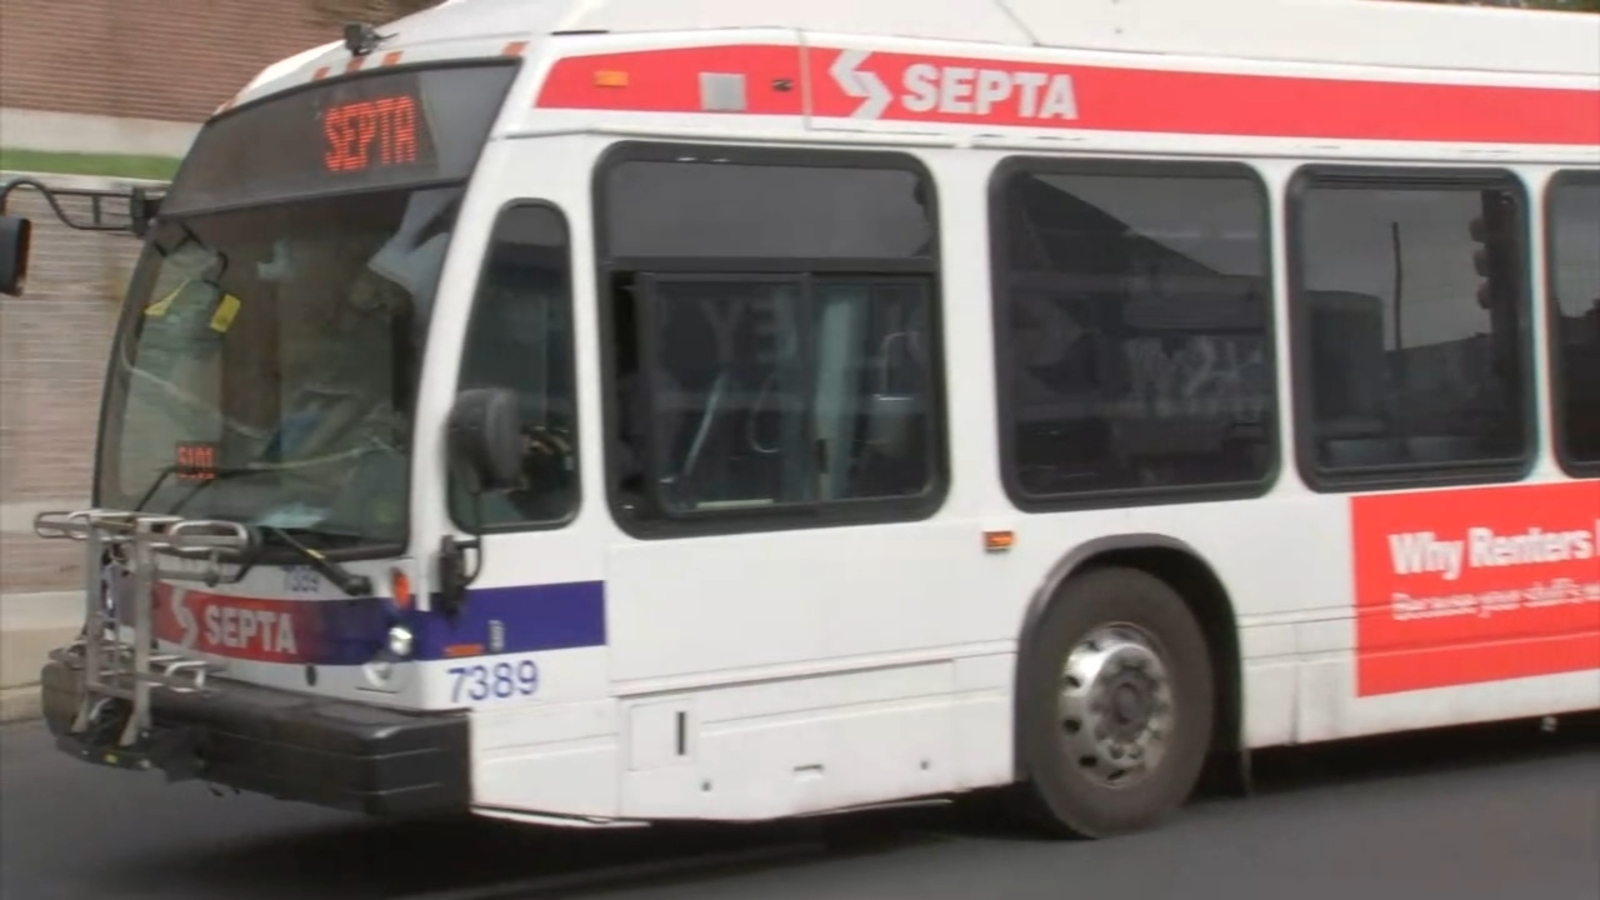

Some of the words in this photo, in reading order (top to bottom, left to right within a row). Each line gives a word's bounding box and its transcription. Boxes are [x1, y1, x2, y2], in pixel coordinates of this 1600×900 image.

[901, 63, 1079, 120] SEPTA
[325, 95, 416, 171] SEPTA
[1388, 531, 1464, 580] Why
[1468, 526, 1594, 567] Renters
[204, 604, 297, 654] SEPTA
[447, 659, 539, 703] 7389
